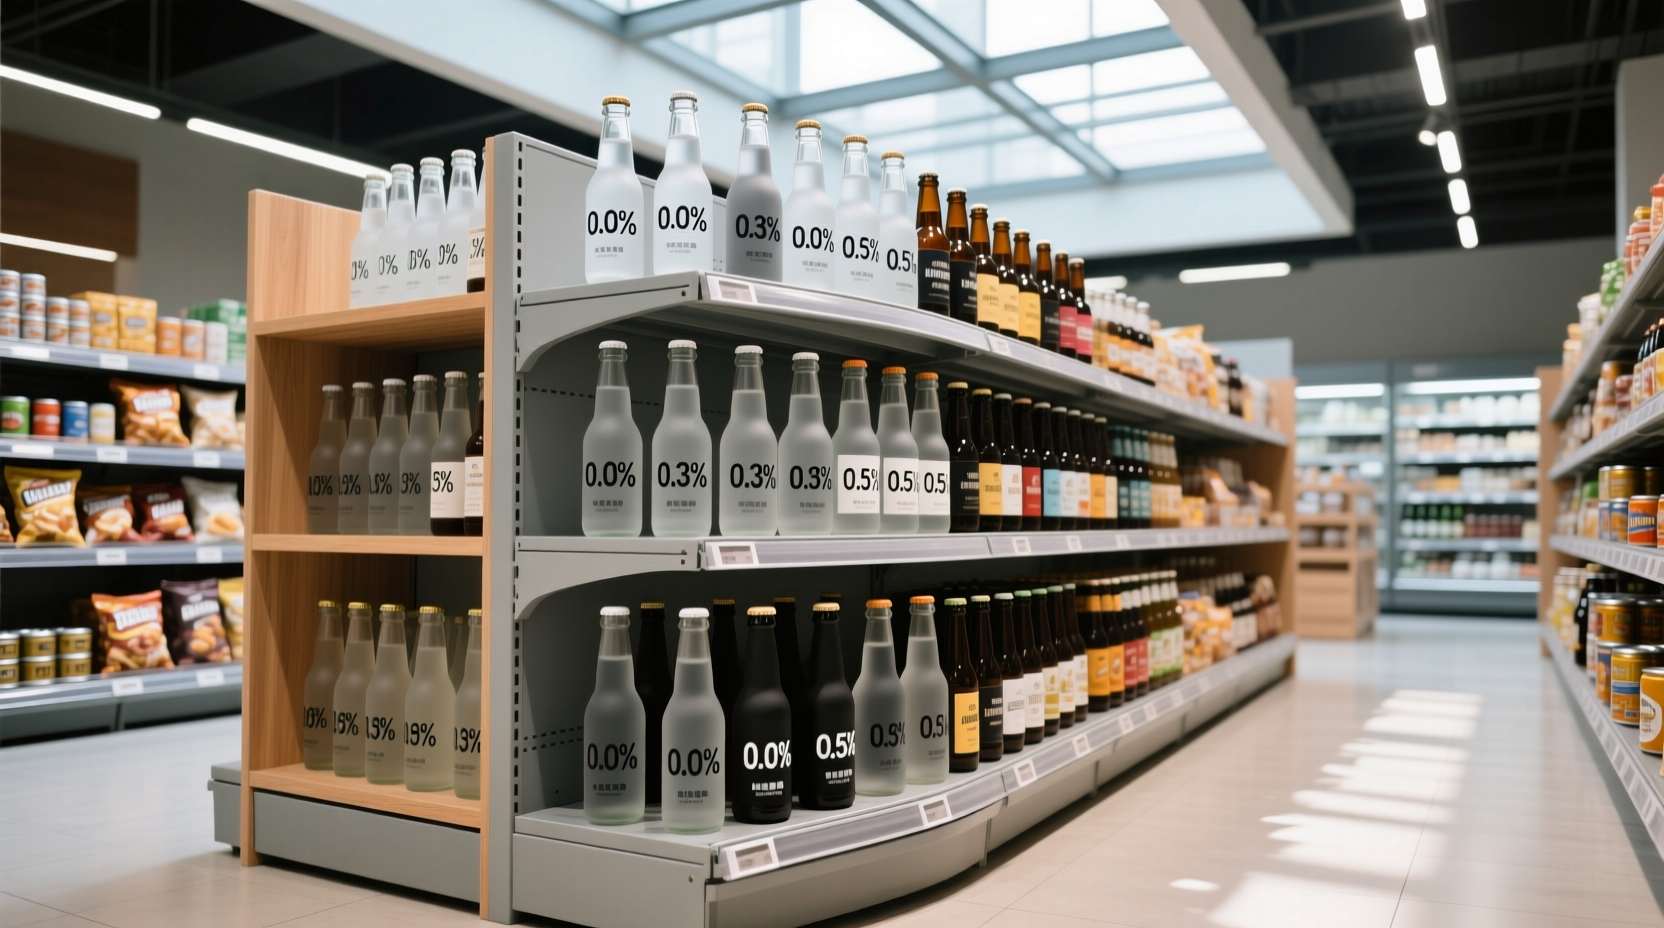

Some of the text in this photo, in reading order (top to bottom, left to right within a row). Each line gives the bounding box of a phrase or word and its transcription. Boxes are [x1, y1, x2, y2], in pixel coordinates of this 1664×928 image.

[588, 209, 636, 235] 0.0%
[658, 205, 707, 232] 0.0%
[735, 214, 780, 242] 0.3%
[792, 226, 834, 253] 0.0%
[842, 235, 879, 263] 0.5%
[432, 470, 454, 493] 5%
[585, 461, 636, 488] 0.0%
[657, 461, 707, 488] 0.3%
[730, 463, 776, 490] 0.3%
[789, 465, 832, 490] 0.3%
[843, 467, 879, 492] 0.5%
[586, 741, 638, 771] 0.0%
[743, 739, 791, 770] 0.0%
[816, 729, 856, 760] 0.5%
[667, 746, 720, 776] 0.0%
